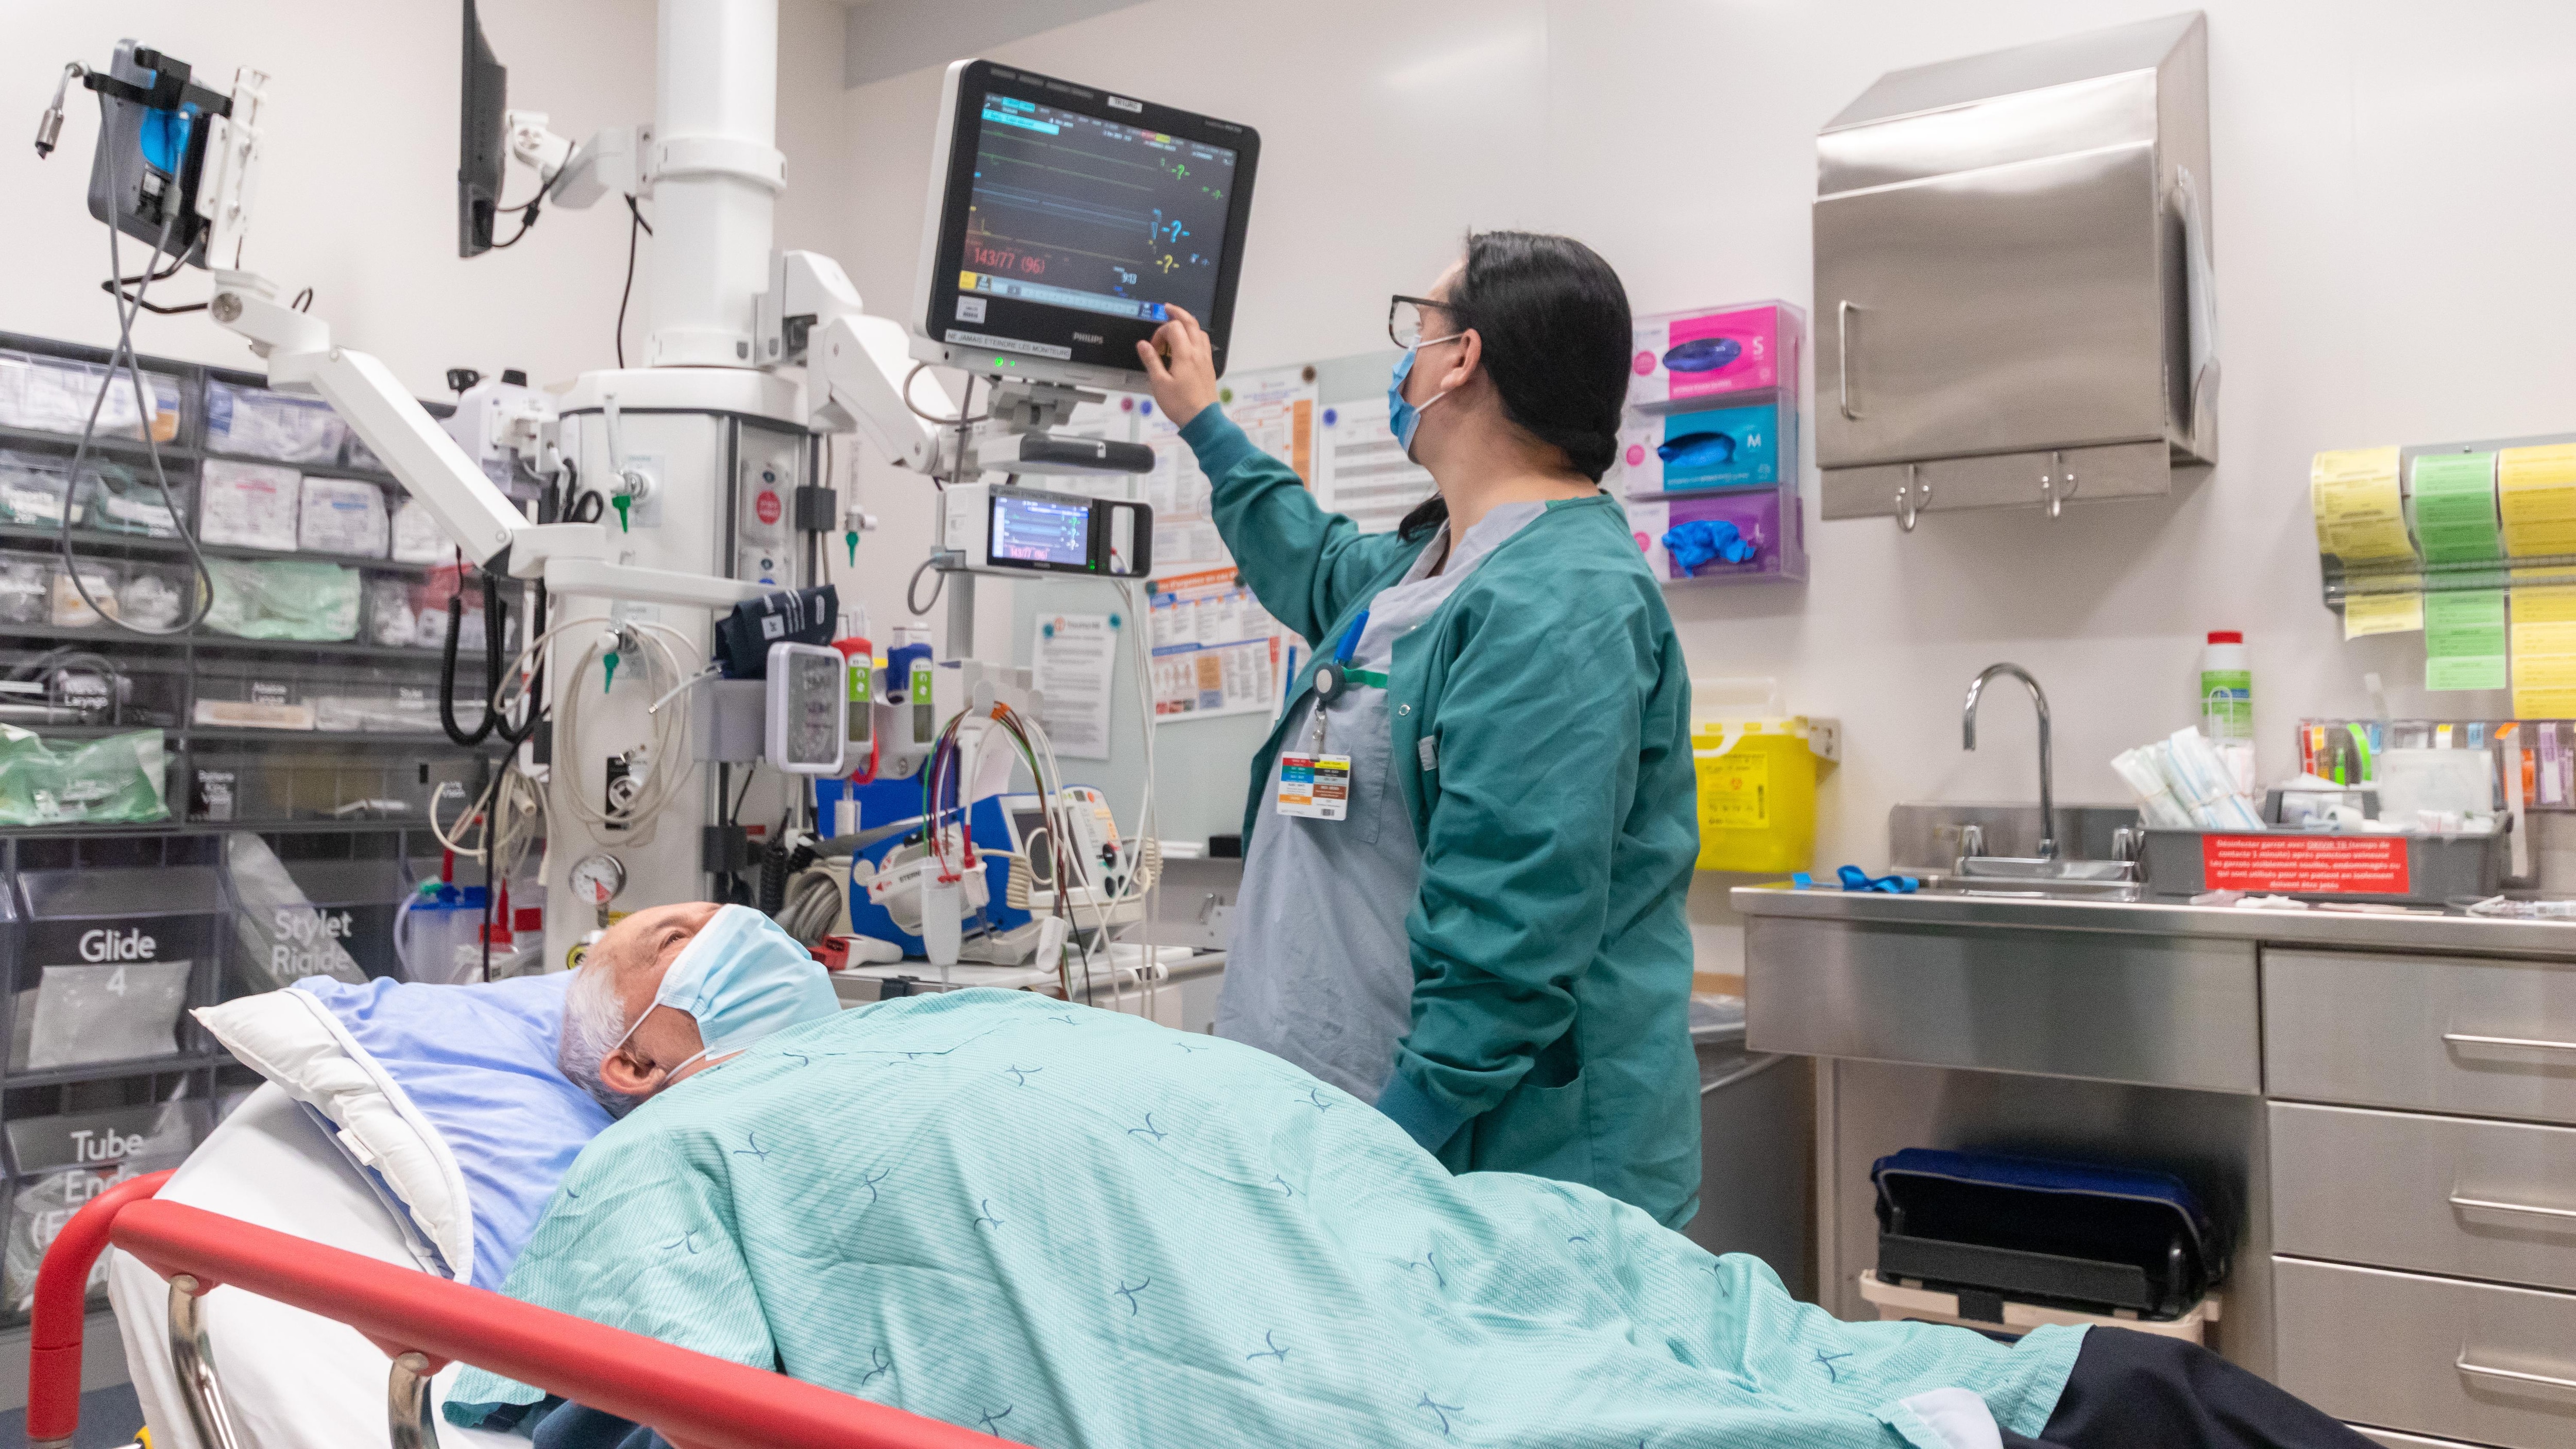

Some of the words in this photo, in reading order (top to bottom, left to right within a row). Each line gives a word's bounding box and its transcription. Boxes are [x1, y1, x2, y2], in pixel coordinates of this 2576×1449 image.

[975, 247, 1015, 269] 143/77
[1073, 331, 1104, 345] PHILIPS
[1753, 336, 1764, 355] S
[1747, 433, 1761, 448] M
[275, 909, 353, 947] Stylet
[79, 928, 157, 962] Glide
[271, 945, 350, 976] Rigide
[106, 966, 128, 997] 4
[71, 1128, 145, 1162] Tube
[65, 1165, 143, 1203] End
